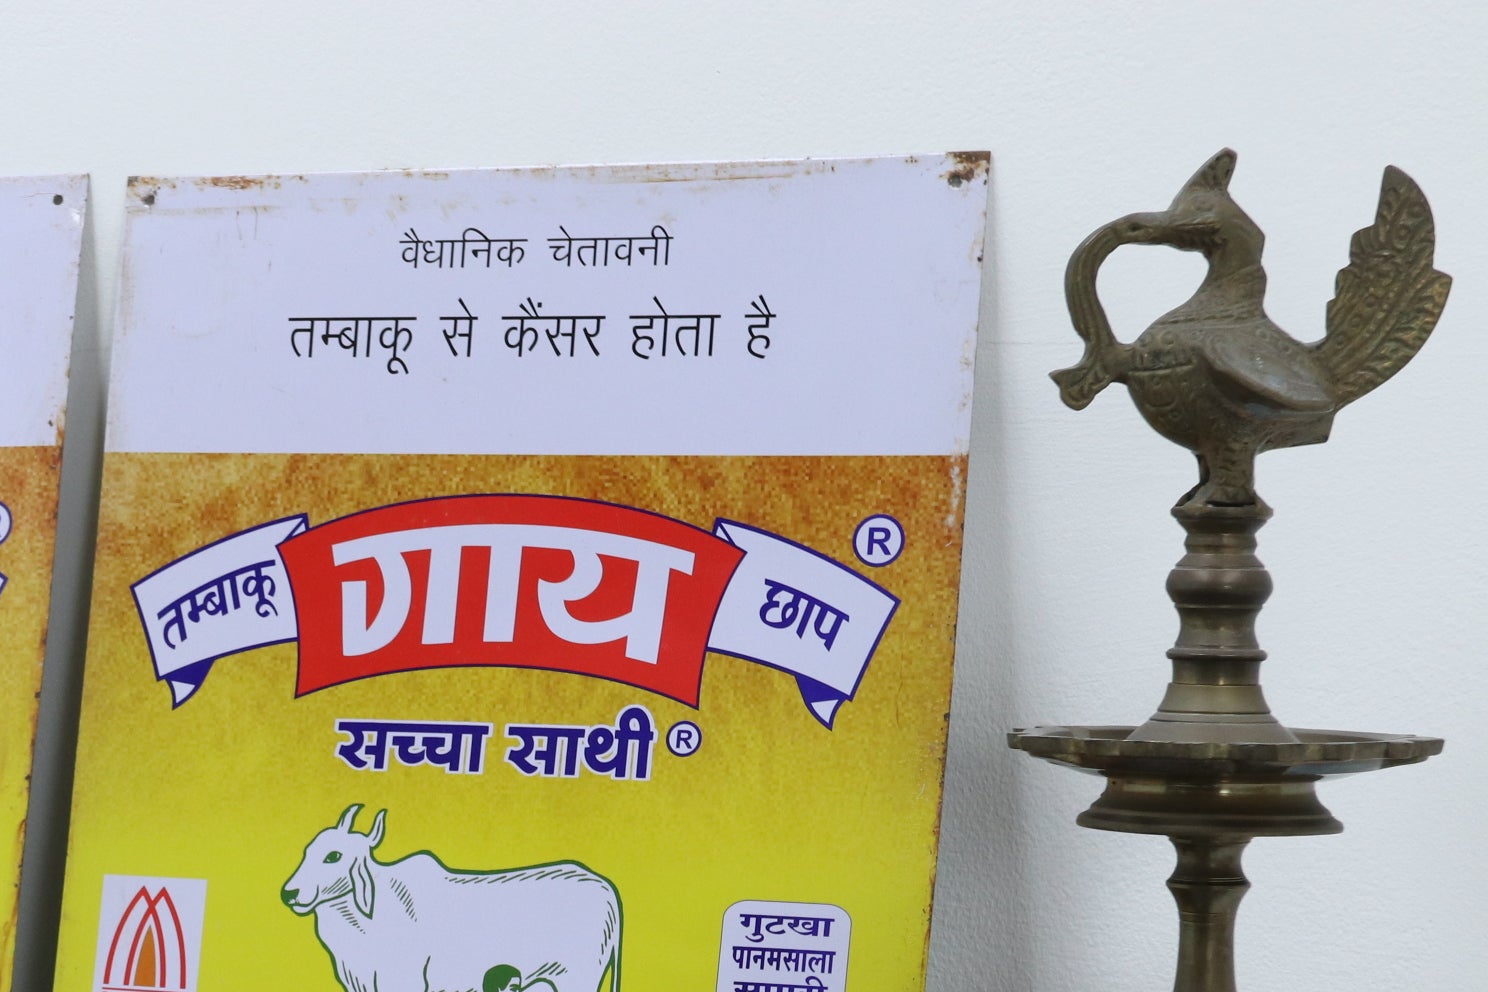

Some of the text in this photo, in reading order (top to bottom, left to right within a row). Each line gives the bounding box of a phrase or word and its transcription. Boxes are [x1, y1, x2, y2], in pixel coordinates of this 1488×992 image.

[400, 226, 674, 270] वैधानिक चेतावनी
[288, 295, 776, 374] तम्बाकू से कैंसर होता है
[157, 558, 277, 650] तम्बाकू
[332, 523, 696, 665] गाय
[759, 578, 849, 651] छाप
[335, 717, 494, 776] सच्चा
[505, 705, 657, 780] साथी
[740, 914, 835, 943] गुटखा
[732, 946, 836, 974] पानमसाला
